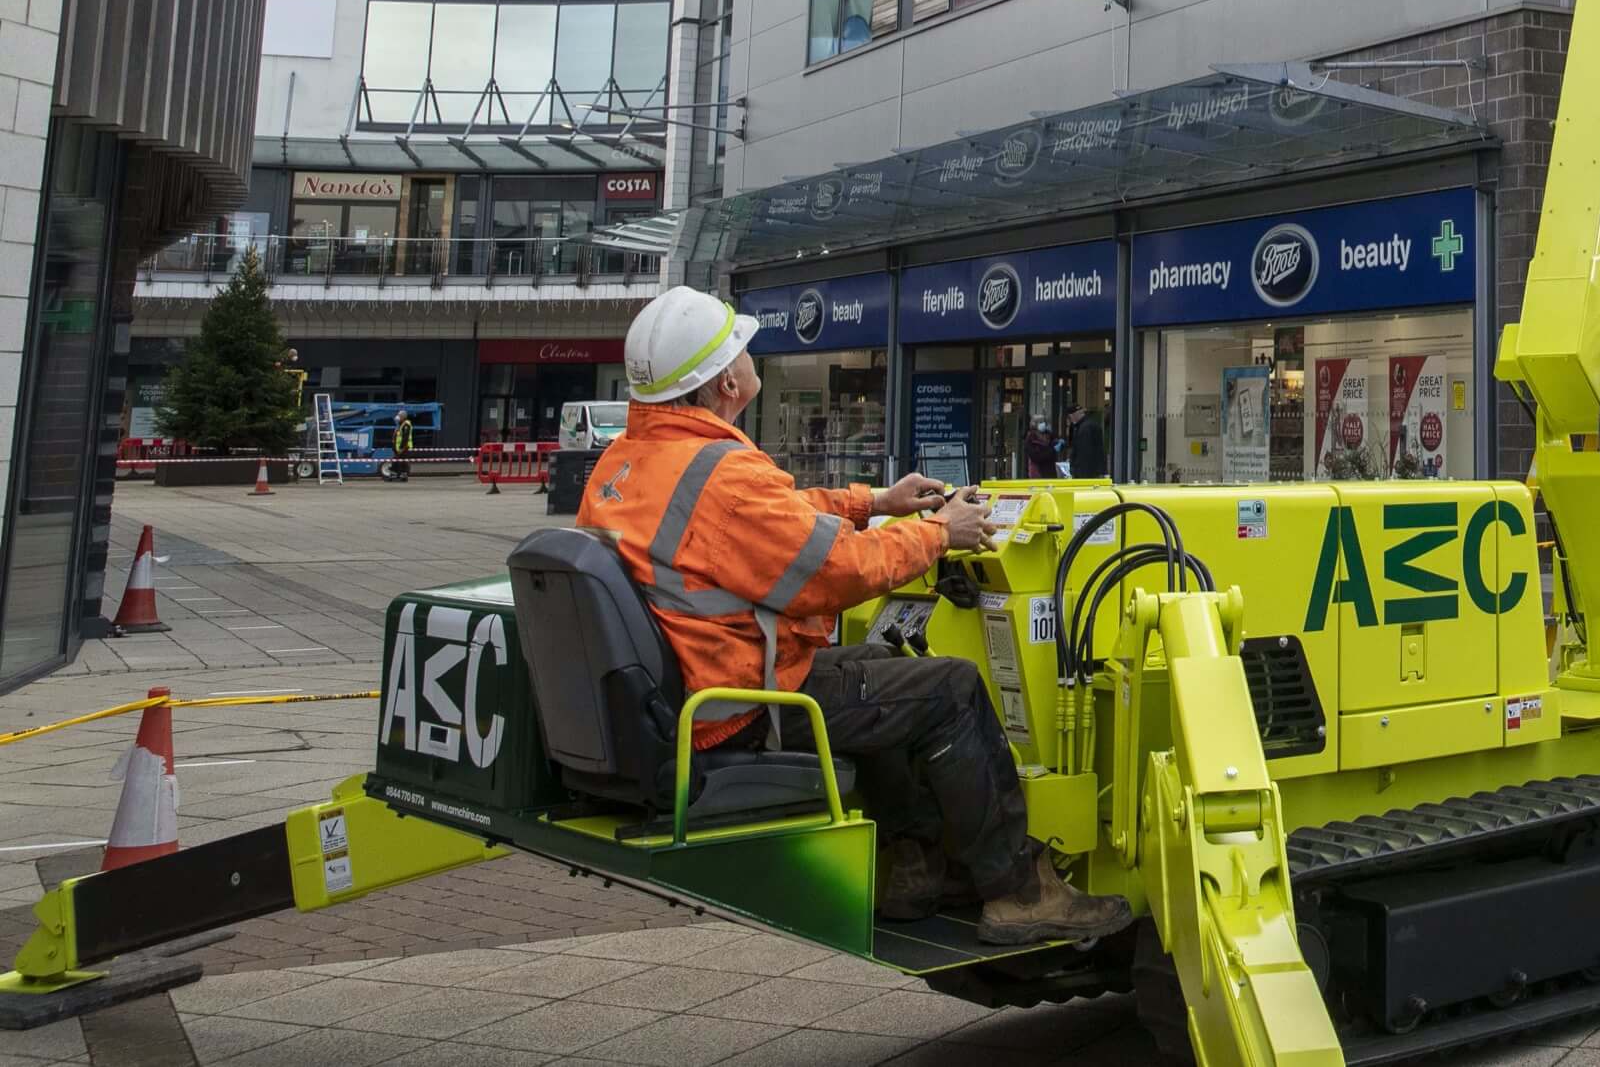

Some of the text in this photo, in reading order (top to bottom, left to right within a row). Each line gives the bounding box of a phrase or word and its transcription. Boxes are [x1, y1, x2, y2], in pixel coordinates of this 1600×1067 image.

[303, 176, 395, 197] Nando's
[607, 178, 651, 193] COSTA
[1149, 233, 1411, 295] pharmacy Boots beauty
[923, 269, 1102, 317] fferyllfa Boots harddwch
[755, 309, 789, 332] harmacy
[832, 300, 864, 324] beauty
[539, 343, 590, 359] Clintons
[1342, 377, 1365, 388] GREAT
[1419, 375, 1443, 387] GREAT
[916, 384, 952, 394] croeso
[1342, 389, 1363, 399] PRICE
[1419, 387, 1441, 398] PRICE
[1343, 429, 1361, 437] PRICE
[1422, 423, 1439, 431] HALF
[1421, 431, 1441, 439] PRICE
[431, 800, 491, 826] www.amchire.com
